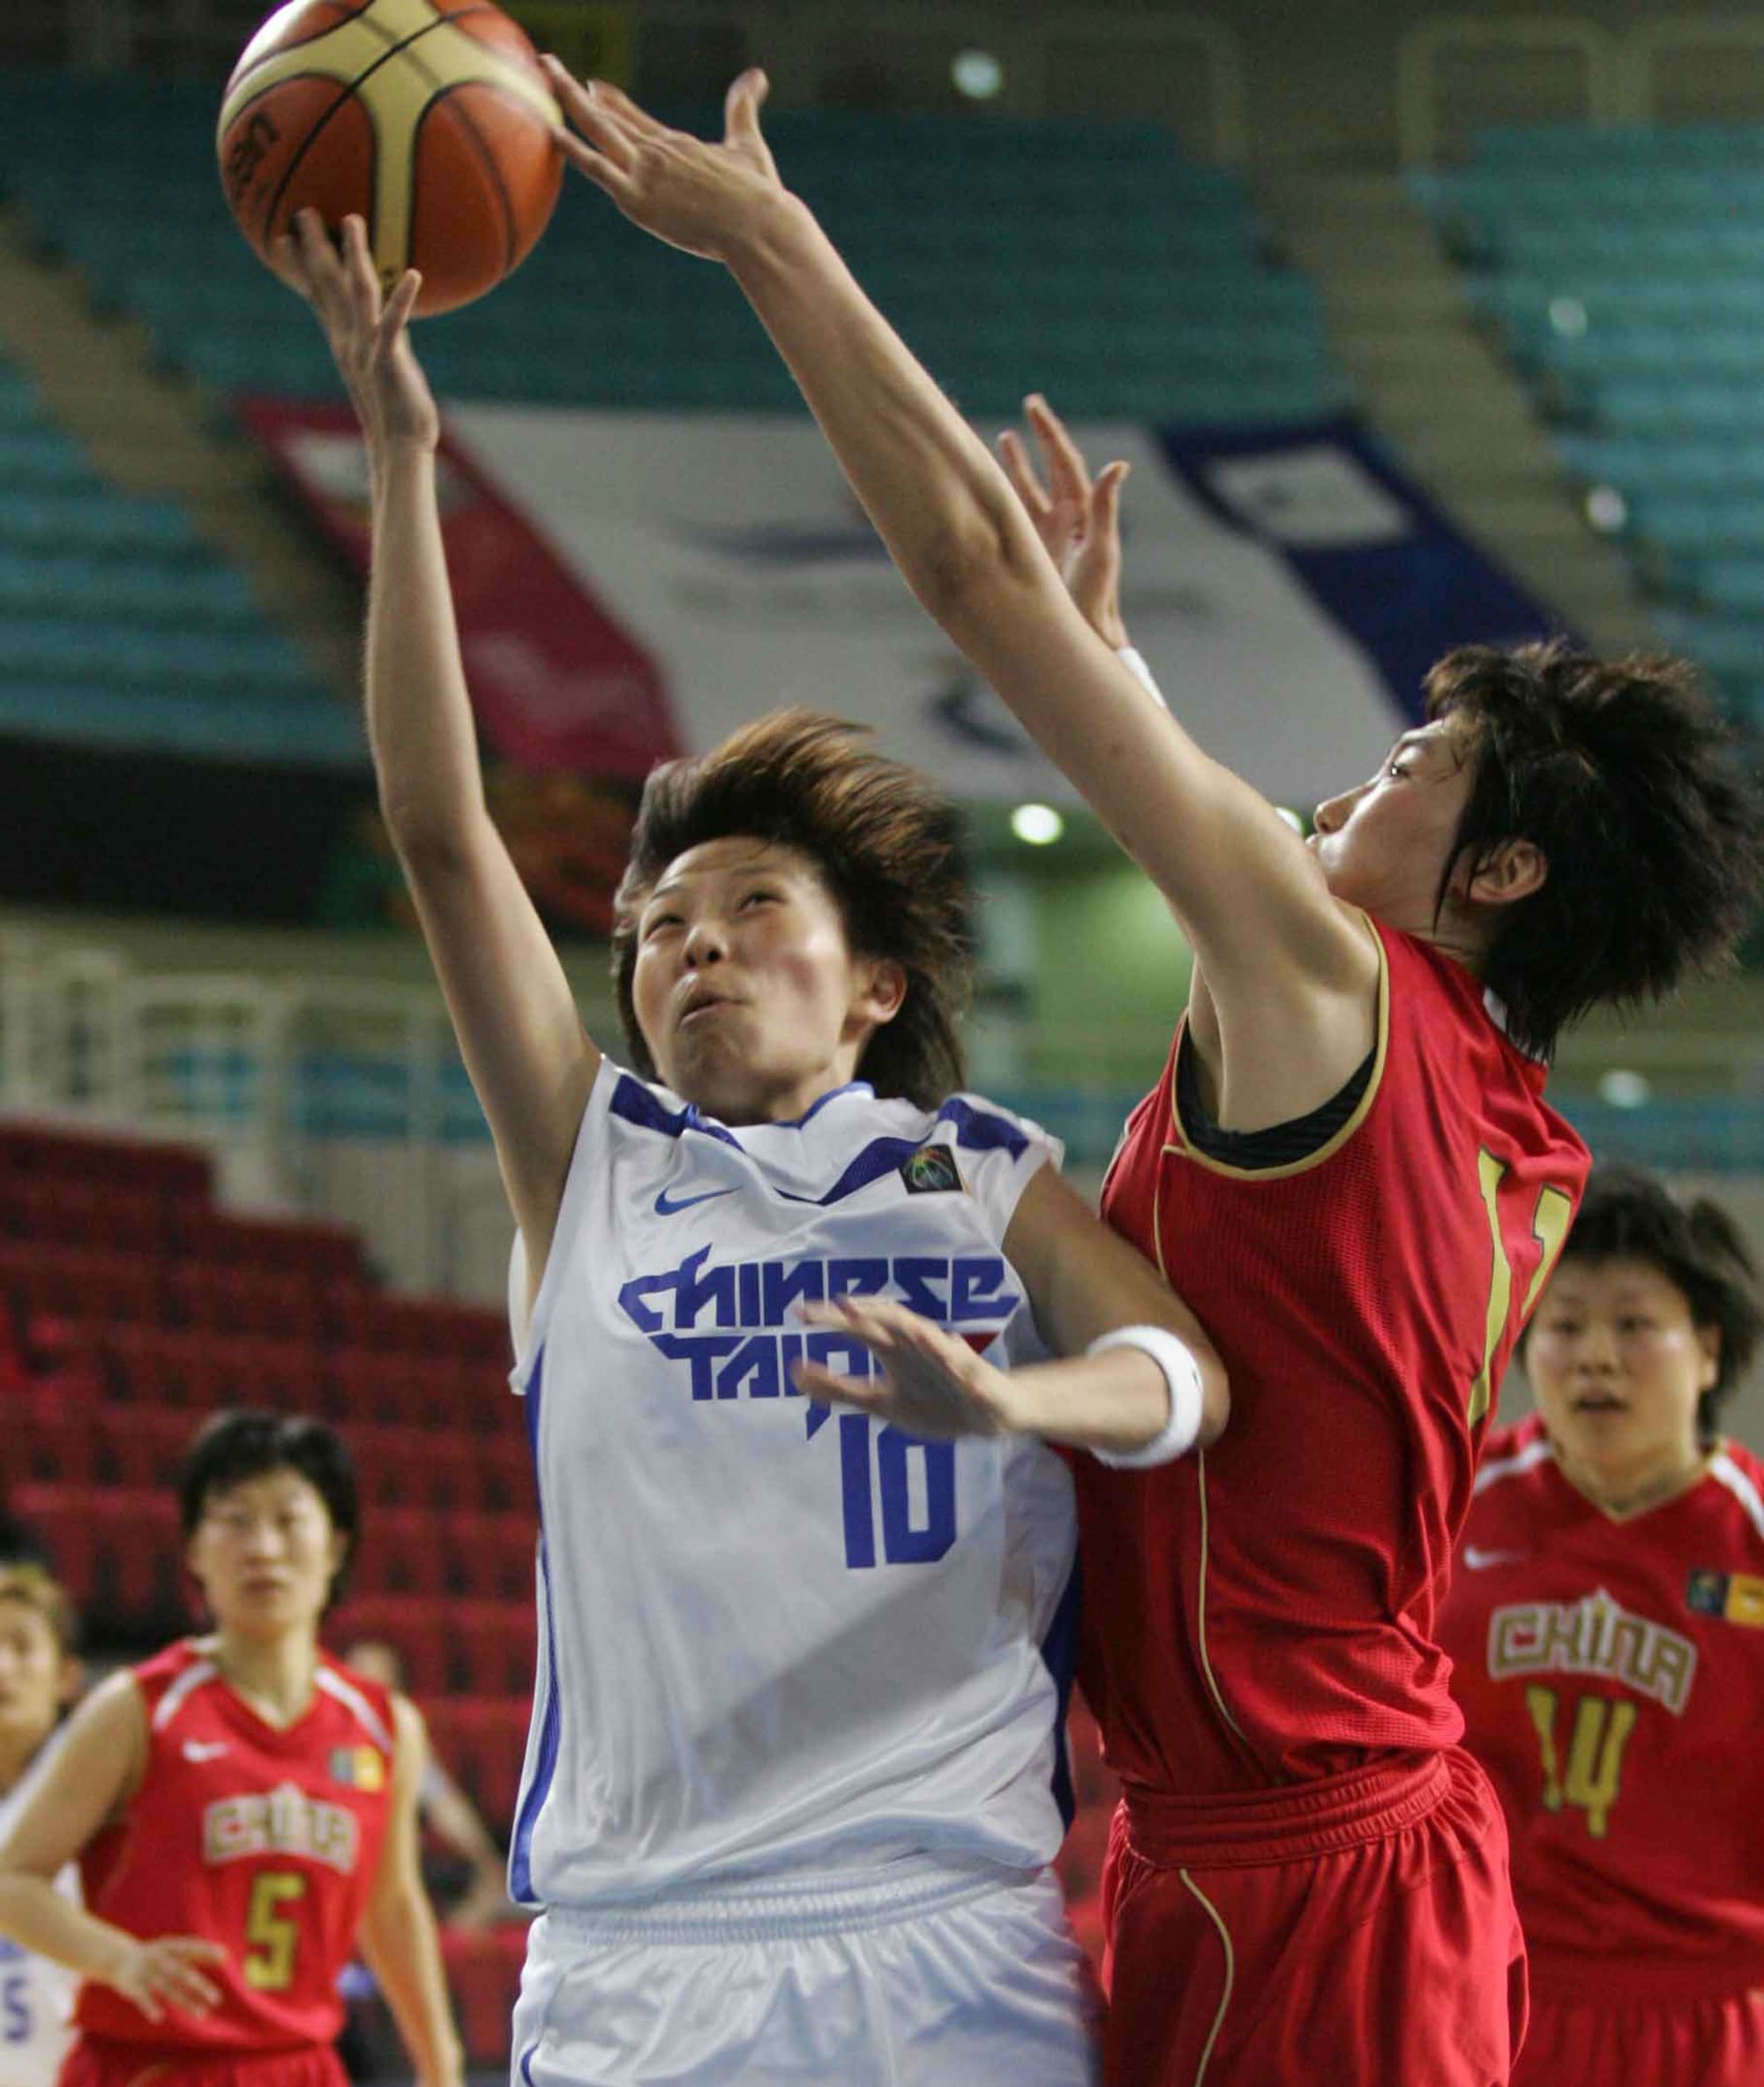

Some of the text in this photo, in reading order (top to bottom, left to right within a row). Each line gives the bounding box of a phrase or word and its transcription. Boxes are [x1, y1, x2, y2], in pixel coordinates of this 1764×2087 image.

[617, 1242, 1020, 1333] CHINESE
[839, 1413, 957, 1569] 10
[1487, 1585, 1699, 1717] CHINA
[1525, 1684, 1637, 1839] 14
[202, 1780, 359, 1875] CHINA
[243, 1871, 305, 1992] 5
